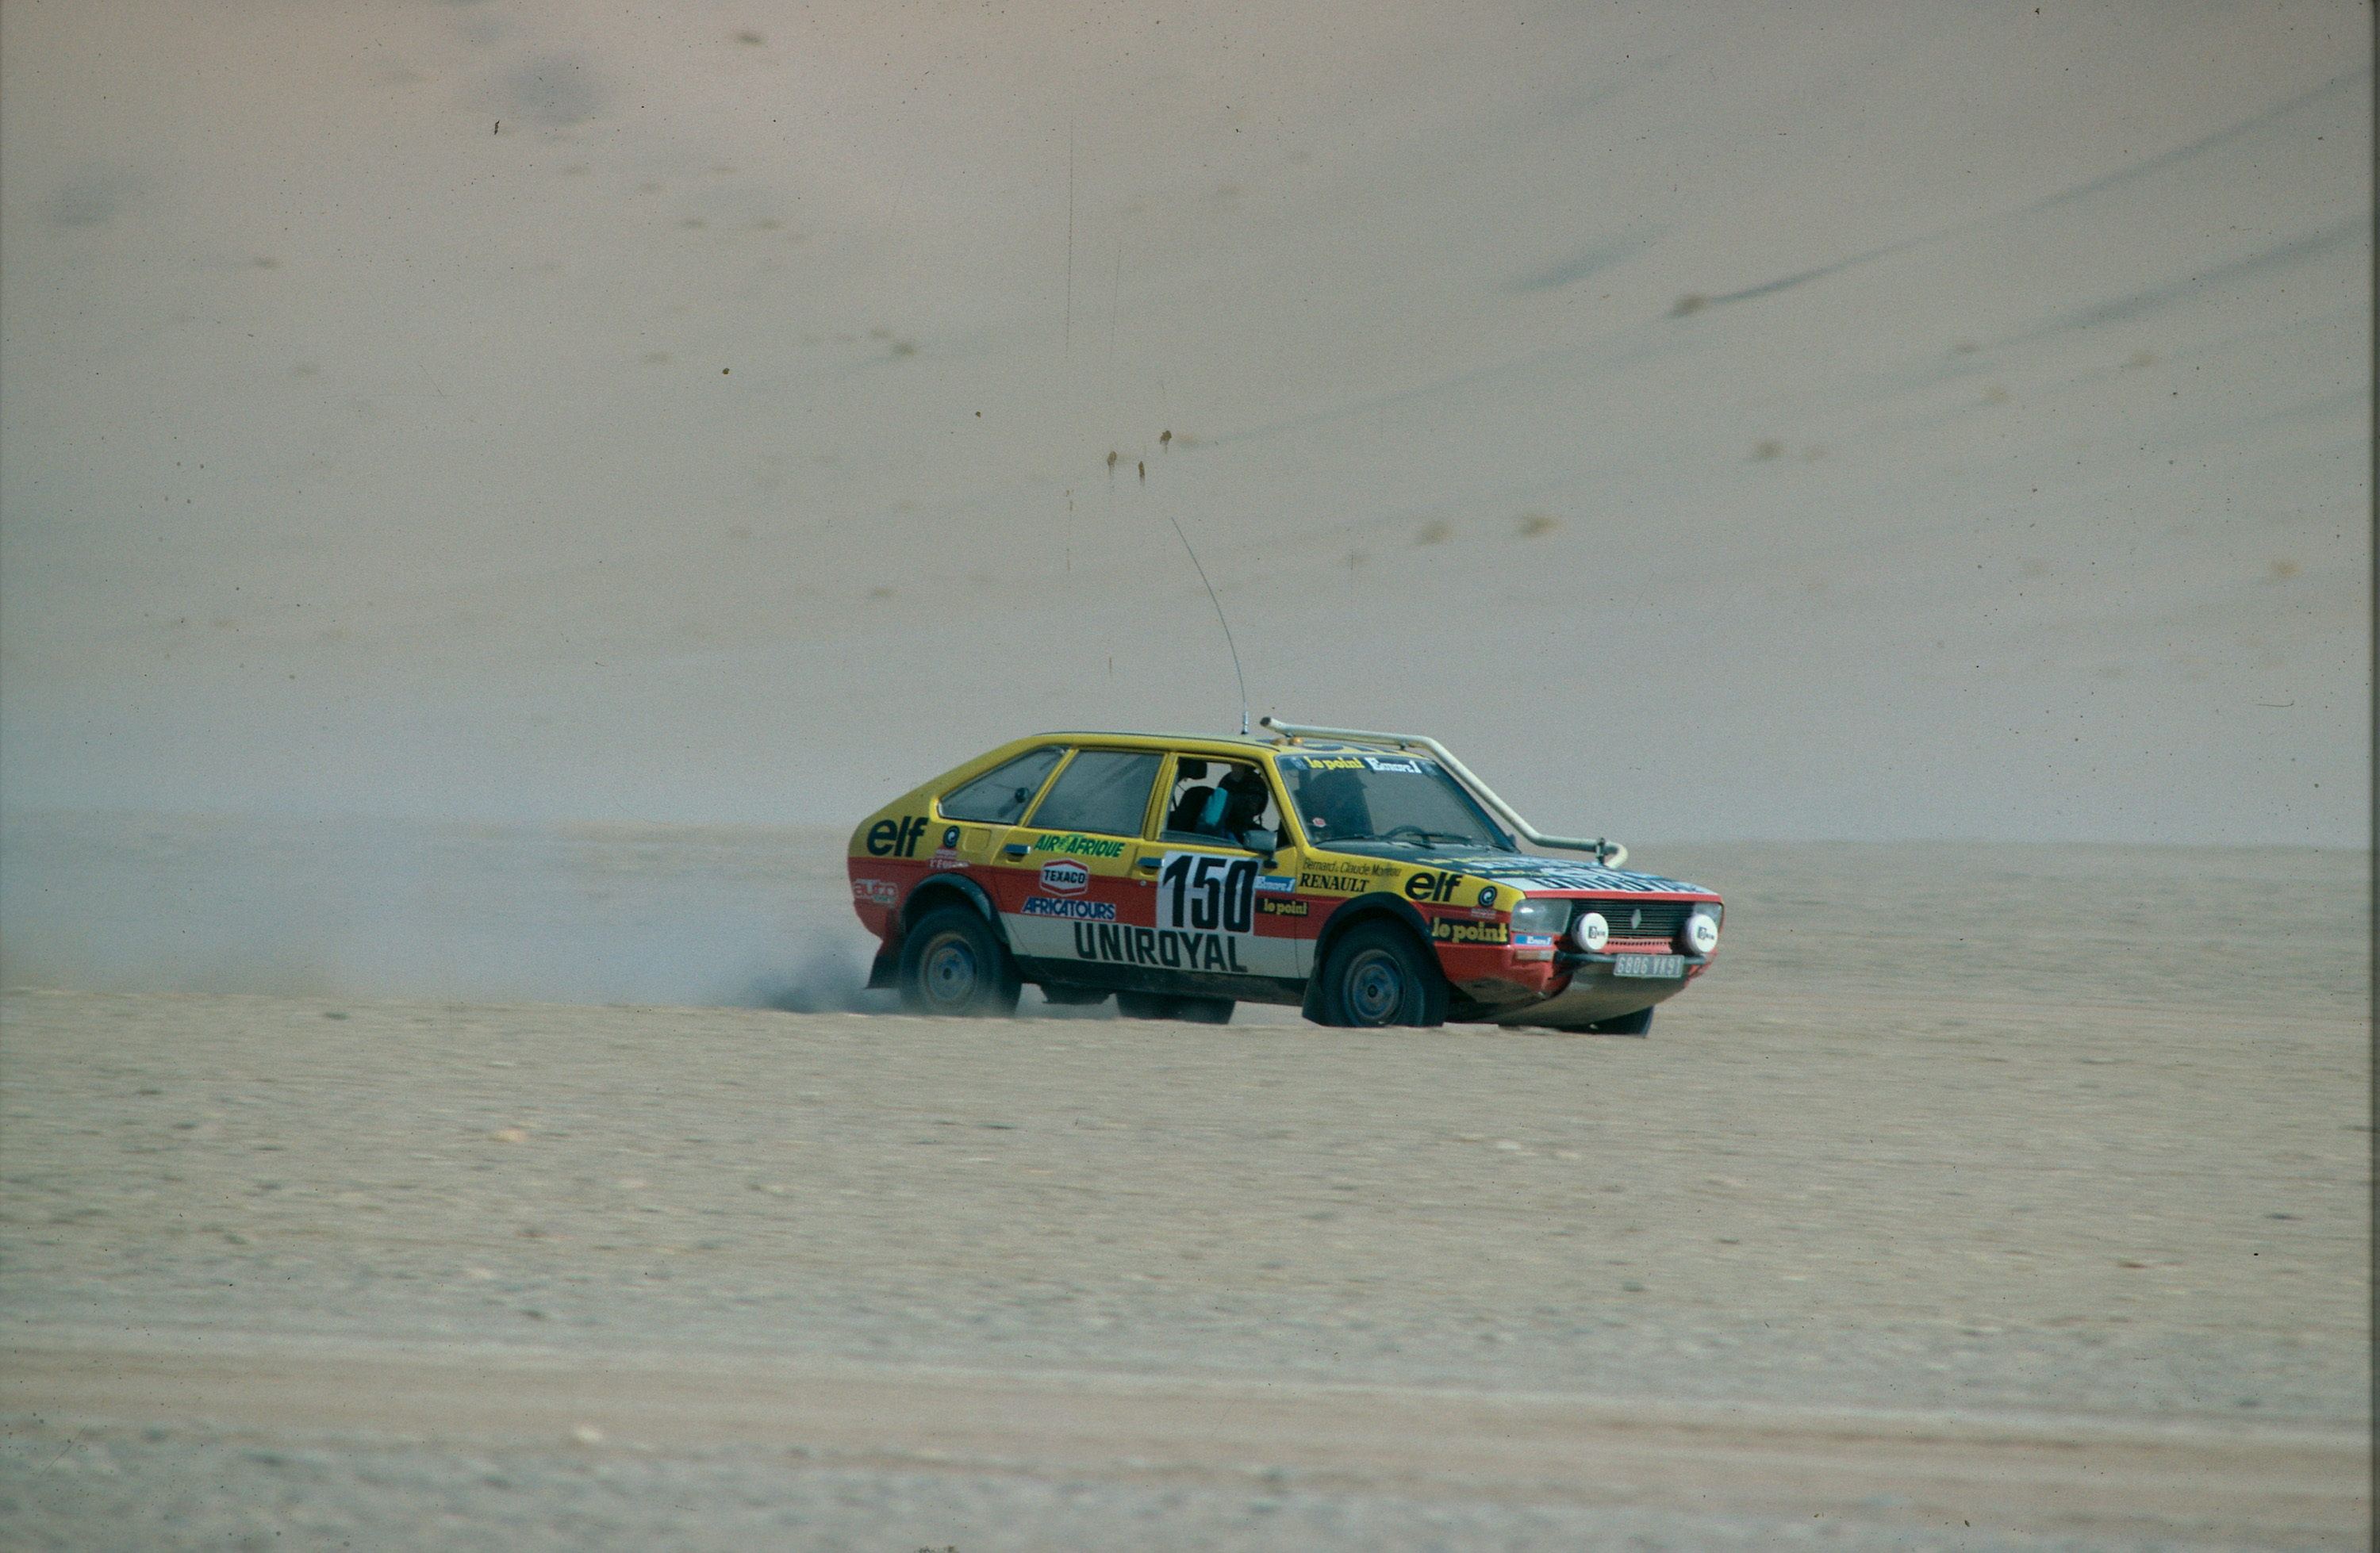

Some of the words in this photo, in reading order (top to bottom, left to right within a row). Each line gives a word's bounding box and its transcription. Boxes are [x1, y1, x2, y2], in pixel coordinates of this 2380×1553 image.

[1303, 756, 1324, 769] le
[1322, 757, 1365, 770] point
[866, 816, 930, 857] elf
[1034, 834, 1060, 852] AIR
[1065, 837, 1126, 857] AFRIQUE
[1044, 869, 1086, 884] TEXACO
[1302, 858, 1336, 871] Bernard
[1340, 861, 1371, 875] Claude
[1162, 855, 1259, 933] 150
[1299, 872, 1369, 893] RENAULT
[1404, 872, 1464, 902] elf
[1023, 896, 1115, 920] AFRICATOURS
[1263, 898, 1275, 912] le
[1276, 901, 1307, 915] point
[1432, 917, 1451, 937] le
[1453, 922, 1507, 943] point
[1073, 921, 1248, 972] UNIROYAL
[1618, 956, 1649, 974] 6806
